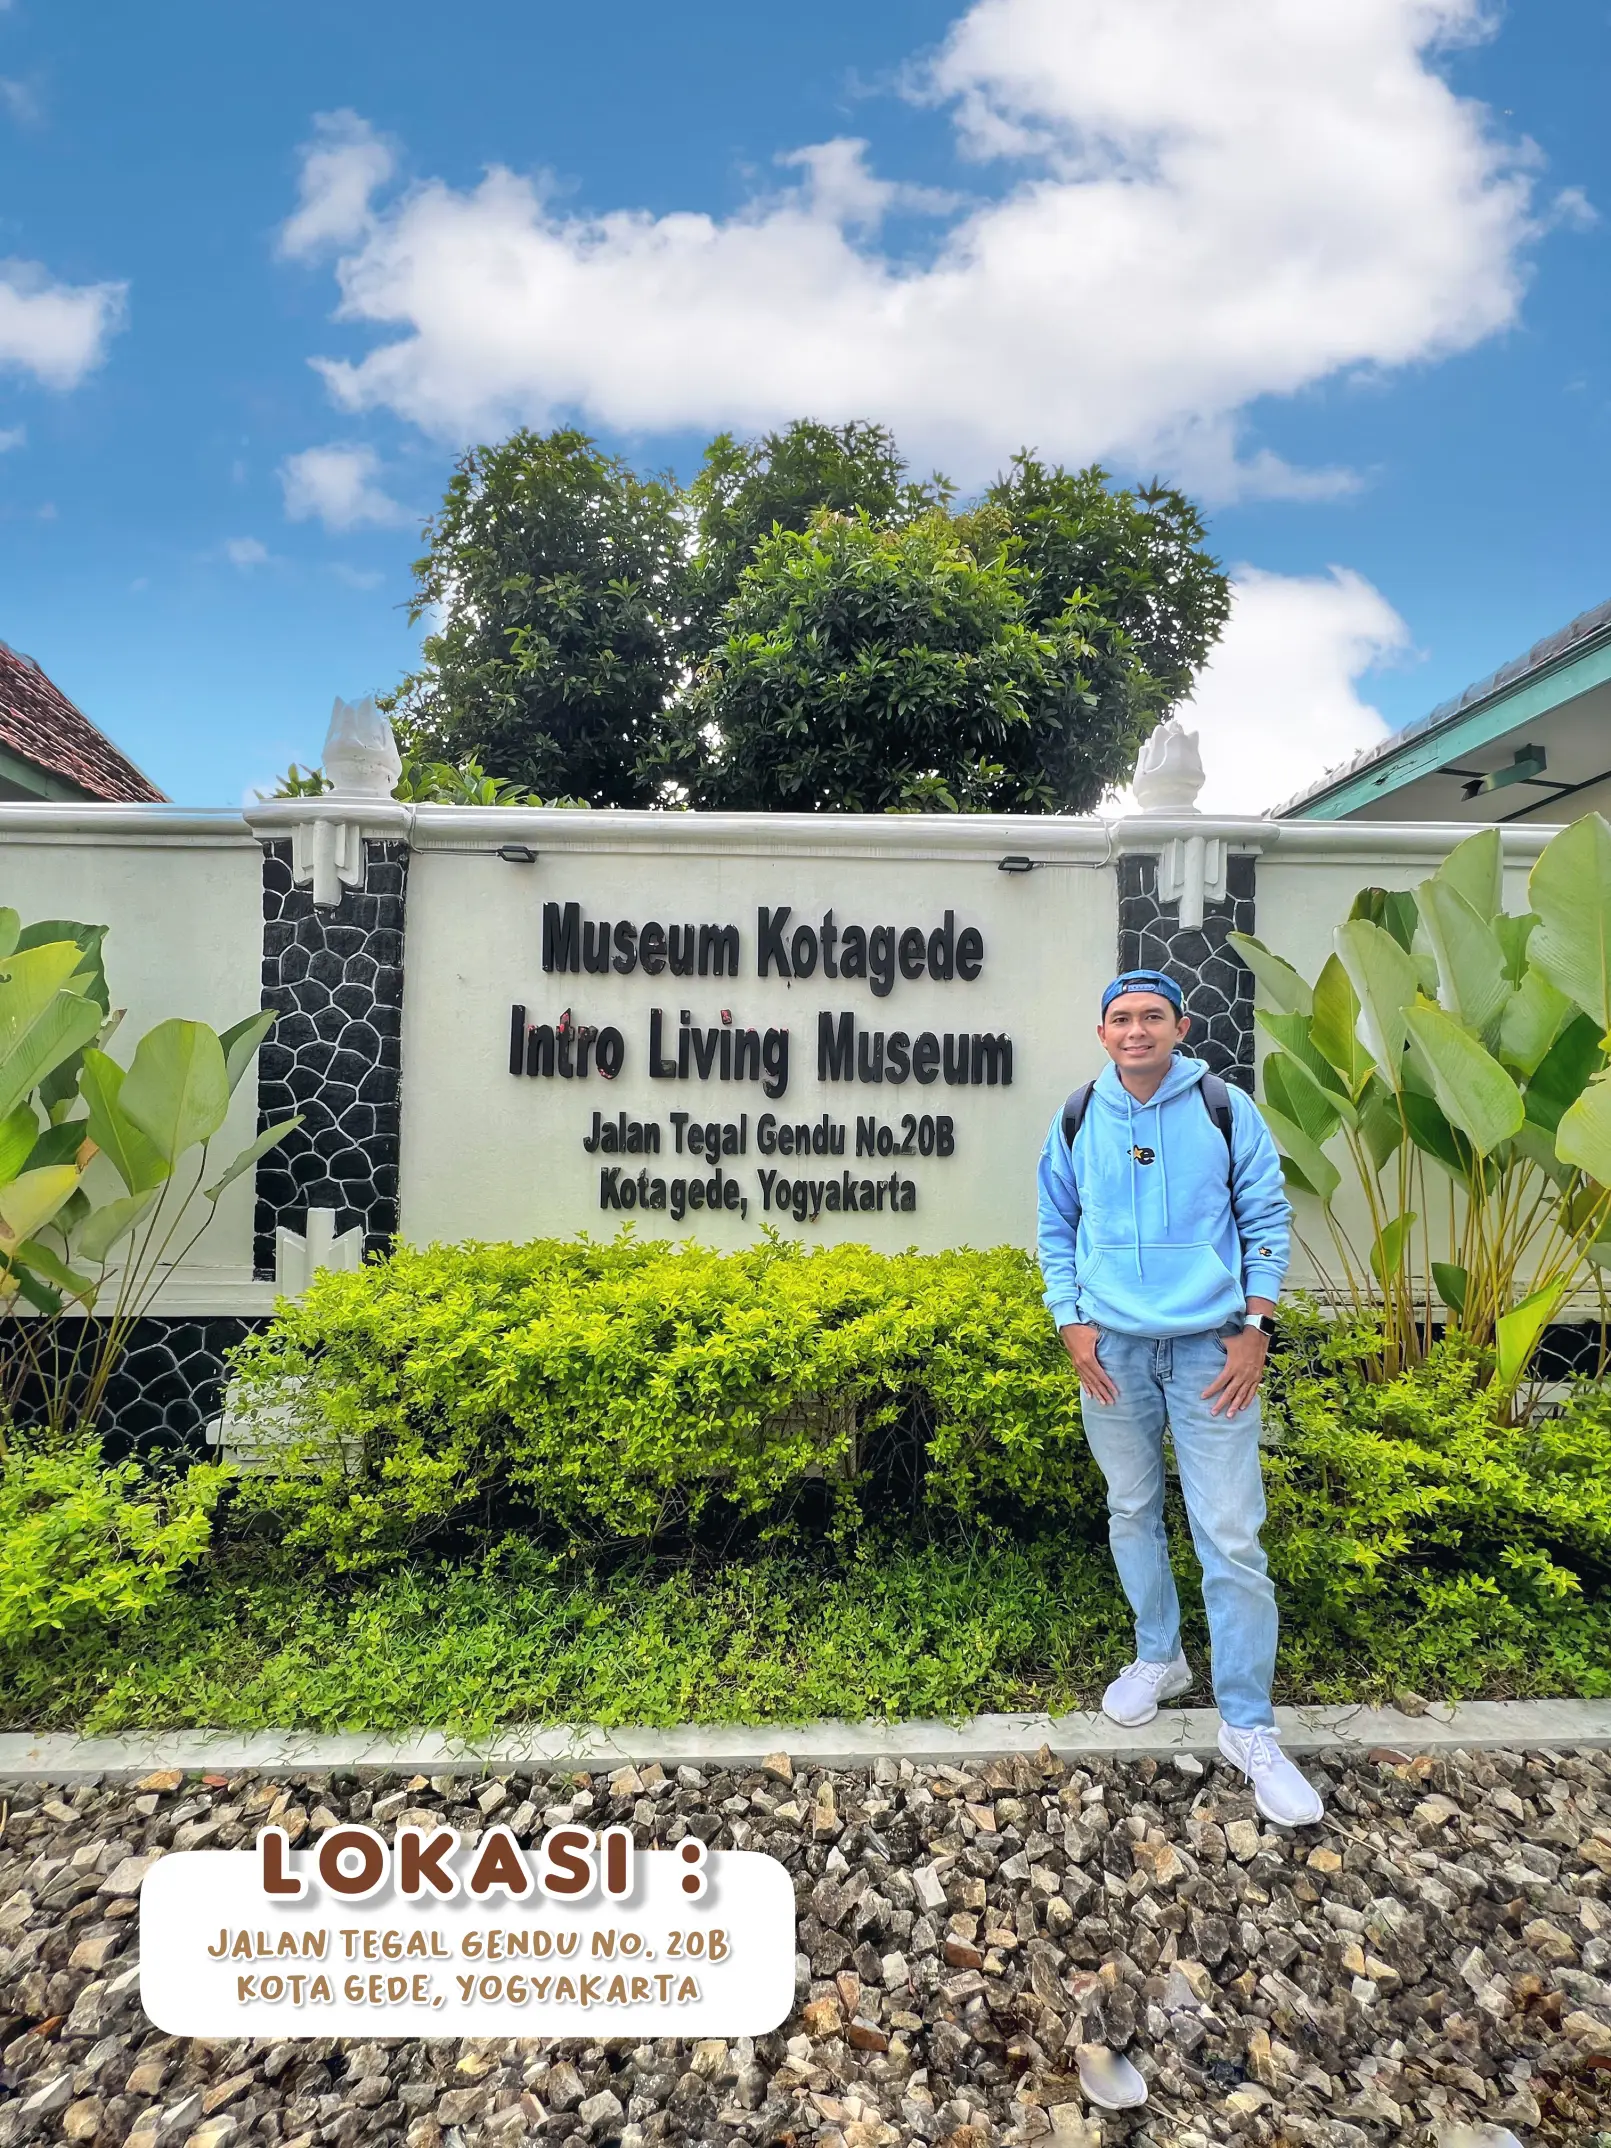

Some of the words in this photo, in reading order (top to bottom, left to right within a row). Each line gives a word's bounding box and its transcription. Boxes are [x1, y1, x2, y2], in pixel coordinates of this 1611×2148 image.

[542, 902, 740, 978] Museum
[757, 906, 985, 998] Kotagede
[509, 1004, 625, 1080] Intro
[649, 1008, 790, 1099] Living
[818, 1011, 1013, 1086] Museum
[583, 1111, 661, 1154] Jalan
[670, 1112, 748, 1165] Tegal
[756, 1113, 846, 1156] Gendu
[856, 1114, 955, 1158] No.20B
[599, 1167, 748, 1222] Kotagede,
[757, 1169, 917, 1224] Yogyakarta
